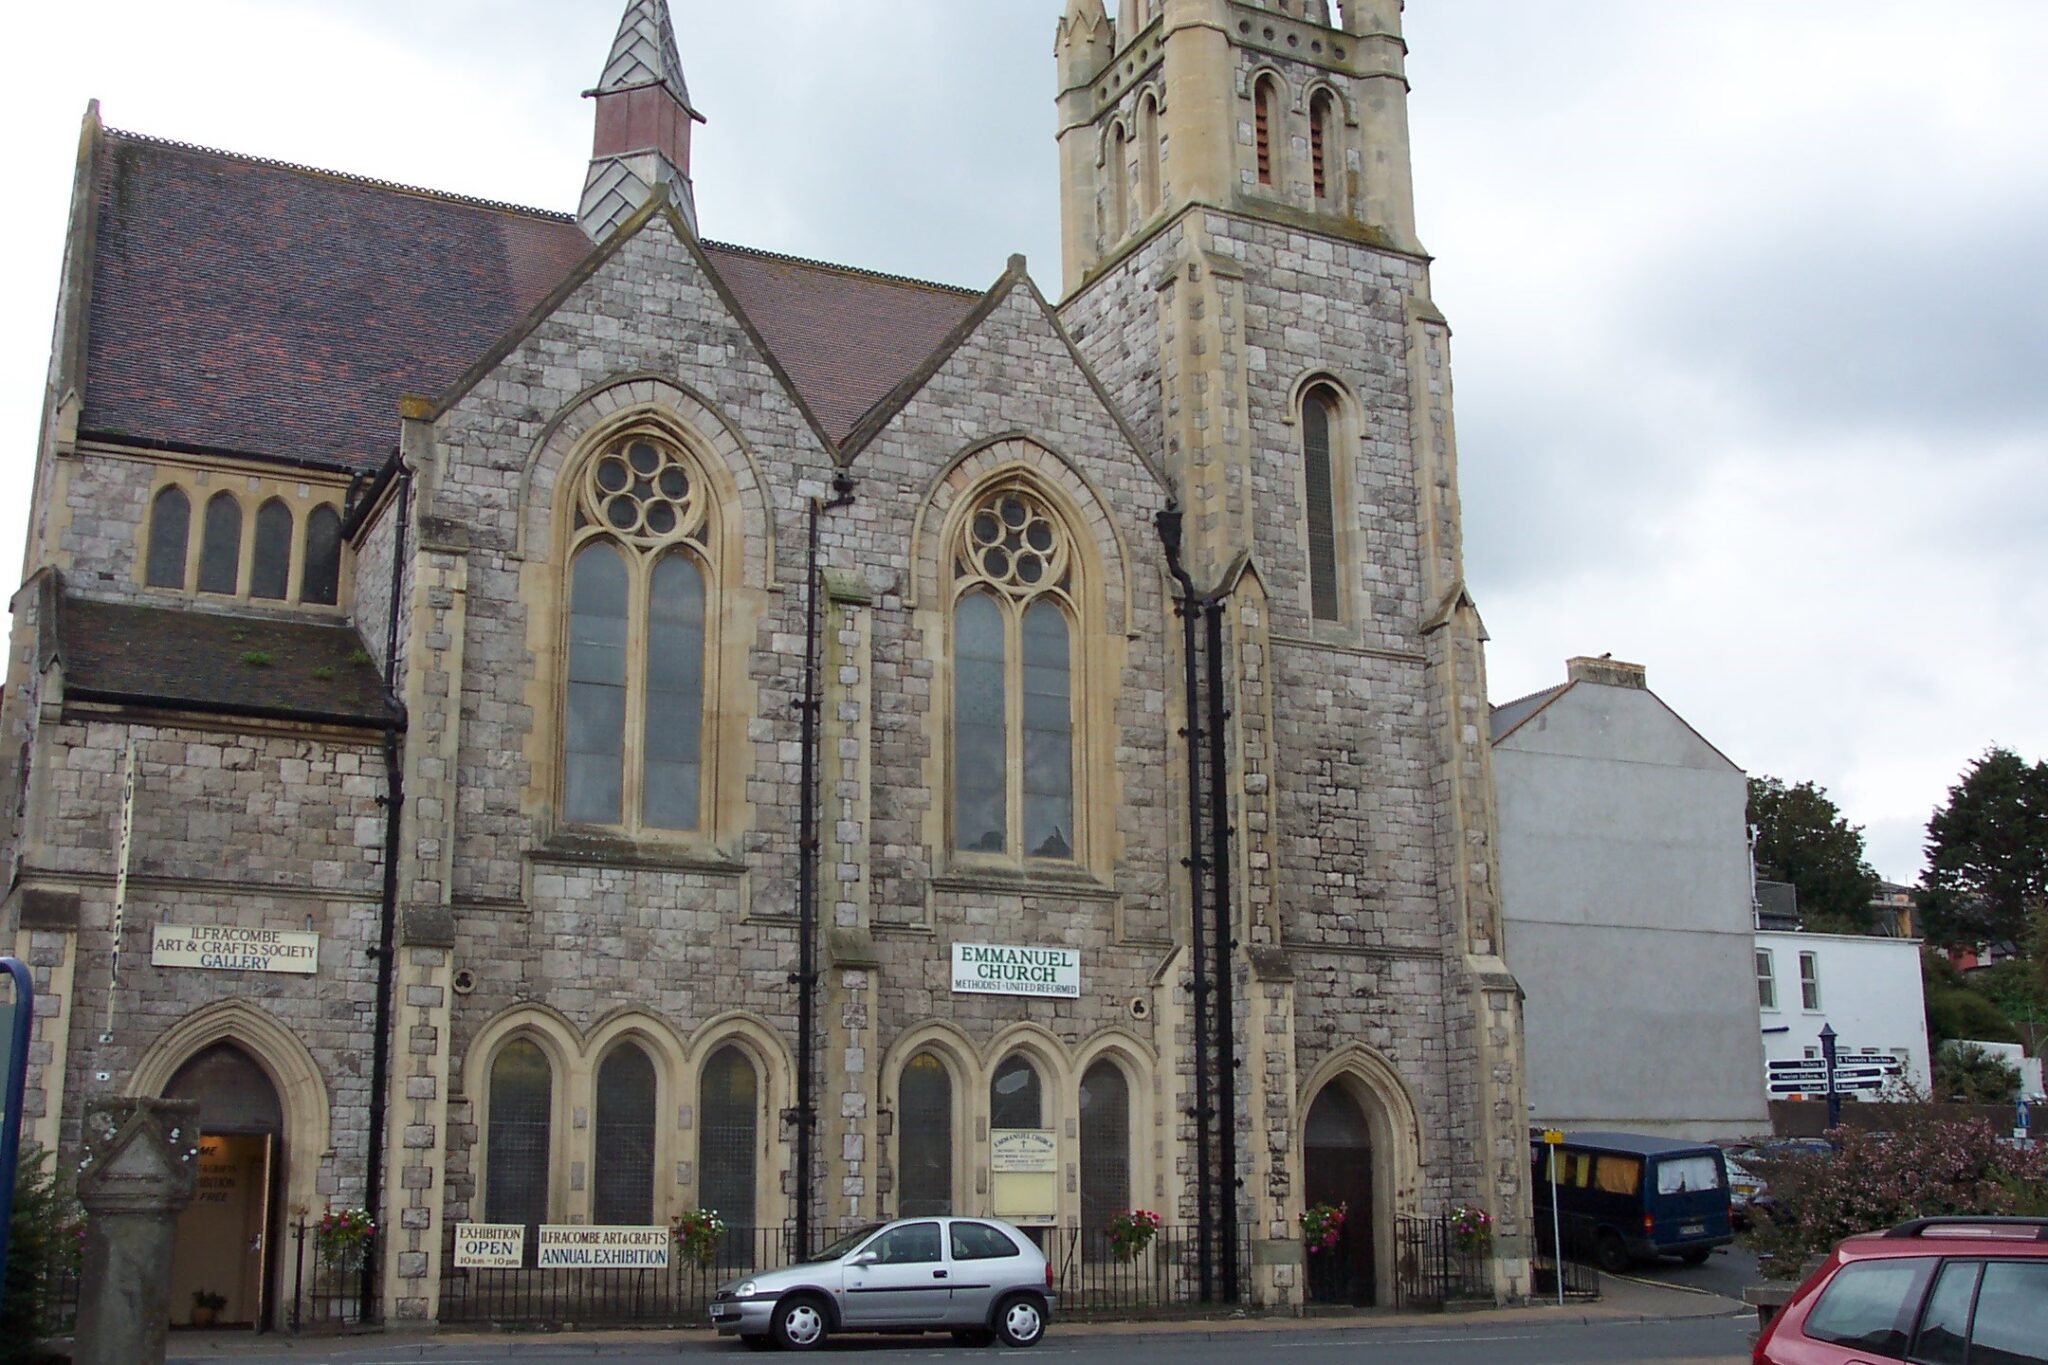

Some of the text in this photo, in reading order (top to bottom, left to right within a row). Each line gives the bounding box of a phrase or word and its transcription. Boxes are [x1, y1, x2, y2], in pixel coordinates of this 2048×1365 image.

[191, 927, 281, 943] ILFRACOMBE
[156, 939, 315, 958] ART & CRAFTS SOCIETY
[201, 954, 271, 969] GALLERY
[961, 947, 1073, 967] EMMANUEL
[977, 964, 1056, 983] CHURCH
[955, 979, 1077, 994] METHODIST UNITED REFORMED
[460, 1228, 521, 1240] EXHIBITION
[541, 1232, 600, 1245] ILFRACOMBE
[465, 1241, 514, 1255] OPEN
[541, 1249, 666, 1265] ANNUAL EXHIBITION
